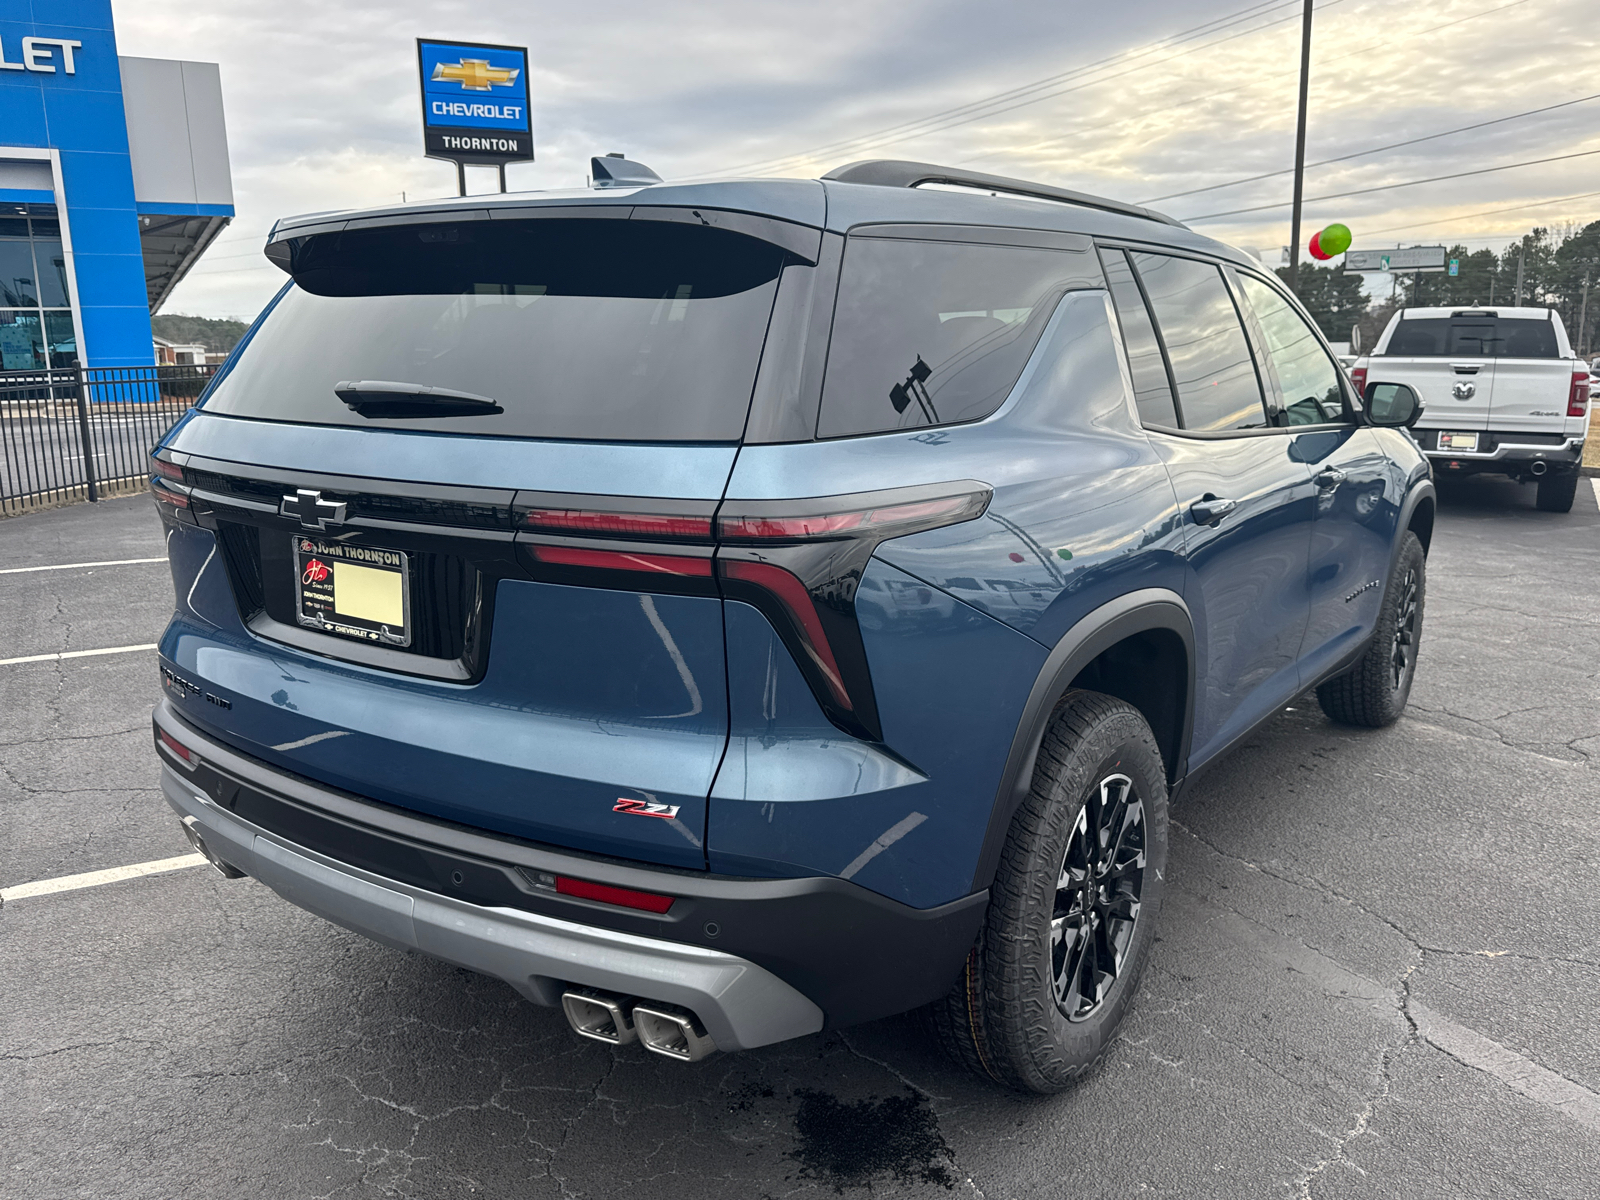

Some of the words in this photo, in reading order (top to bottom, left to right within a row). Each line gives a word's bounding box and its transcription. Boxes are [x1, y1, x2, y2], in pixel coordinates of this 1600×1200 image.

[432, 101, 522, 119] CHEVROLET
[442, 136, 518, 151] THORNTON
[317, 542, 343, 556] JOHN
[344, 547, 400, 565] THORNTON
[335, 626, 368, 638] CHEVROLET
[612, 797, 681, 819] Z71
